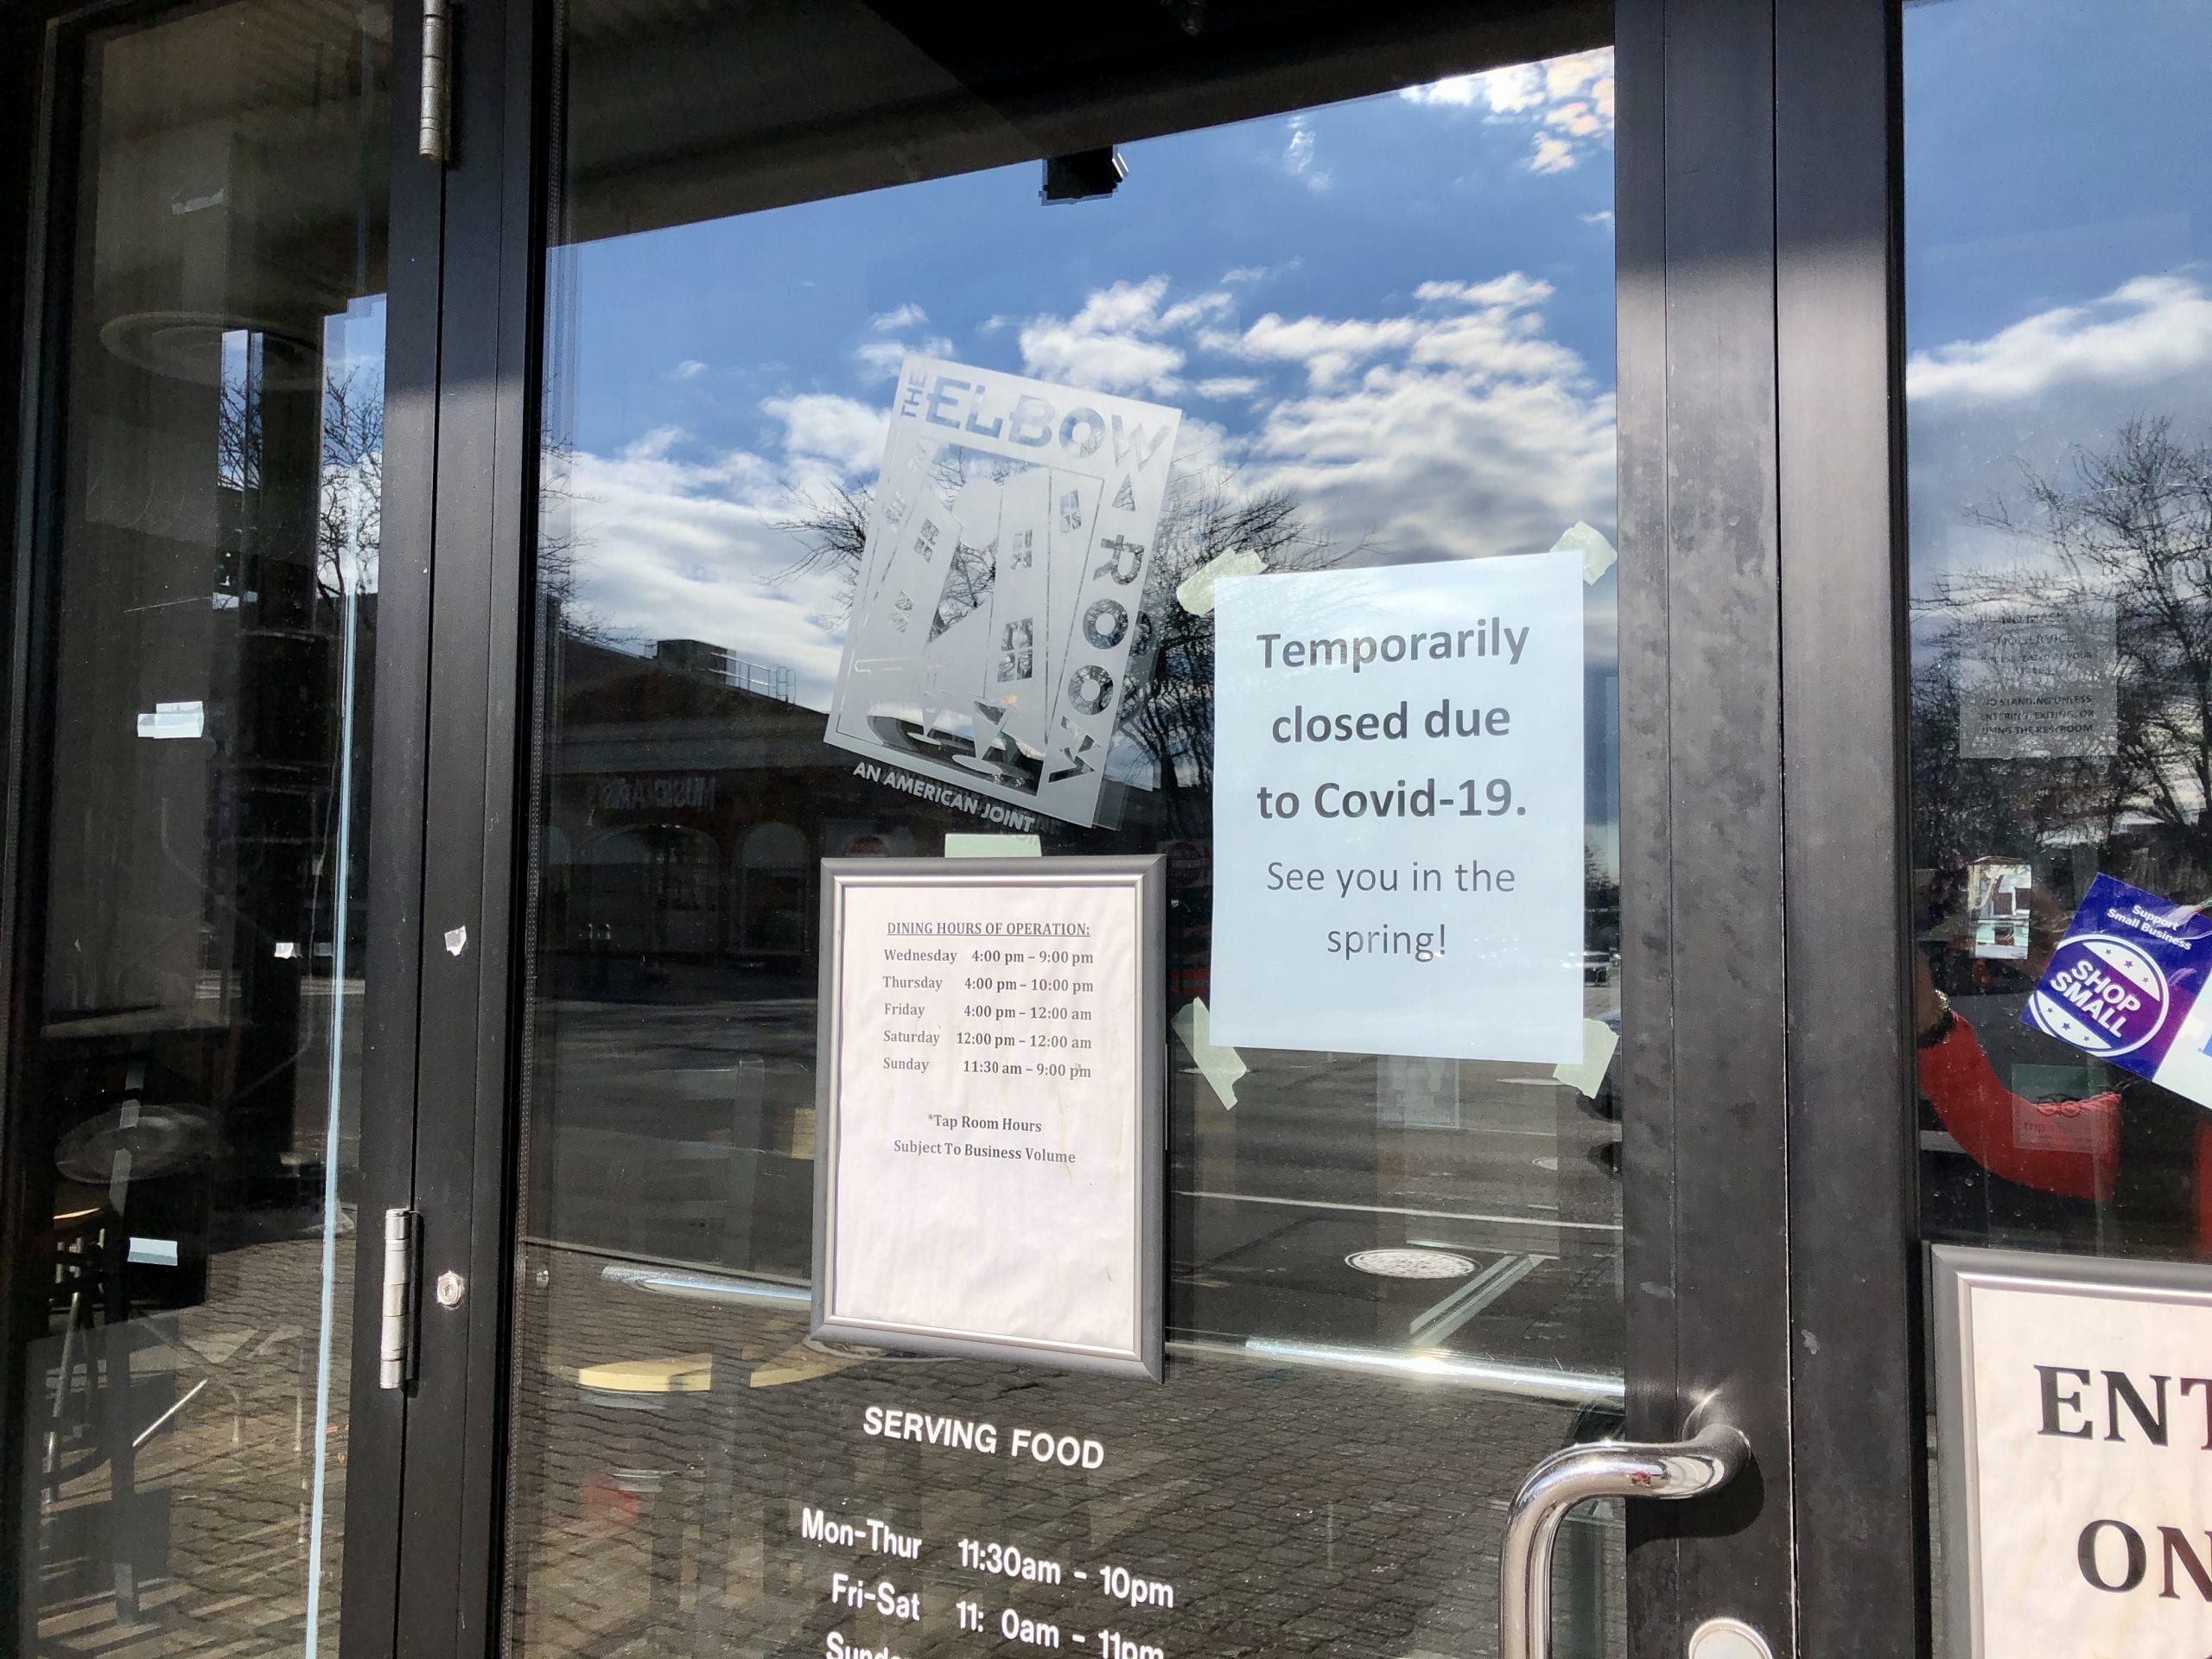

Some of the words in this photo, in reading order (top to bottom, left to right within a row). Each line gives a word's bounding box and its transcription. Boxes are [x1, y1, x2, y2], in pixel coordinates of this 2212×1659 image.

[900, 372, 927, 418] THE
[925, 375, 1173, 473] ELBOW
[1048, 534, 1146, 783] ROOM
[1255, 616, 1530, 674] Temporarily
[1272, 700, 1408, 744] closed
[1424, 698, 1510, 739] due
[1999, 696, 2052, 706] STANDNG
[2014, 725, 2035, 734] THE
[852, 761, 881, 783] AN
[883, 771, 979, 815] AMERICAN
[980, 803, 1036, 833] JOINT
[1256, 786, 1300, 819] to
[1314, 778, 1526, 818] Covid-19.
[1267, 861, 1325, 891] See
[1336, 868, 1398, 899] you
[1413, 861, 1441, 892] in
[1454, 860, 1516, 893] the
[887, 922, 933, 935] DINING
[937, 923, 983, 936] HOURS
[984, 923, 1003, 936] OF
[1006, 923, 1090, 937] OPERATION:
[2107, 908, 2141, 929] Small
[2140, 921, 2193, 951] Business
[2132, 904, 2179, 931] Support
[883, 948, 958, 965] Wednesday
[971, 950, 1001, 963] 4:00
[1004, 953, 1024, 966] pm
[1039, 950, 1069, 963] 9:00
[1071, 954, 1094, 967] pm
[1327, 924, 1446, 963] spring!
[882, 976, 944, 992] Thursday
[964, 977, 993, 990] 4:00
[996, 981, 1017, 994] pm
[1031, 978, 1069, 992] 10:00
[1071, 982, 1094, 995] pm
[2050, 970, 2127, 1039] SMALL
[2070, 960, 2141, 1012] SHOP
[884, 1002, 926, 1020] Friday
[963, 1005, 992, 1018] 4:00
[995, 1008, 1016, 1021] pm
[1030, 1006, 1068, 1020] 12:00
[1071, 1010, 1092, 1020] am
[883, 1029, 941, 1047] Saturday
[957, 1032, 992, 1046] 12:00
[994, 1036, 1015, 1049] pm
[1029, 1034, 1068, 1048] 12:00
[1071, 1039, 1092, 1049] am
[882, 1057, 930, 1074] Sunday
[963, 1060, 999, 1074] 11:30
[1001, 1065, 1023, 1075] am
[1036, 1063, 1066, 1077] 9:00
[1069, 1066, 1091, 1080] pm
[961, 1116, 999, 1130] Room
[1001, 1117, 1042, 1133] Hours
[893, 1140, 943, 1157] Subject
[944, 1142, 962, 1155] To
[964, 1143, 1022, 1160] Business
[1025, 1147, 1077, 1164] Volume
[862, 1406, 997, 1454] SERVING
[1011, 1428, 1104, 1470] FOOD
[802, 1507, 923, 1560] Mon-Thur
[957, 1538, 1061, 1586] 11:30am
[1099, 1565, 1174, 1609] 10pm
[831, 1572, 920, 1621] Fri-Sat
[1097, 1629, 1164, 1659] 11pm
